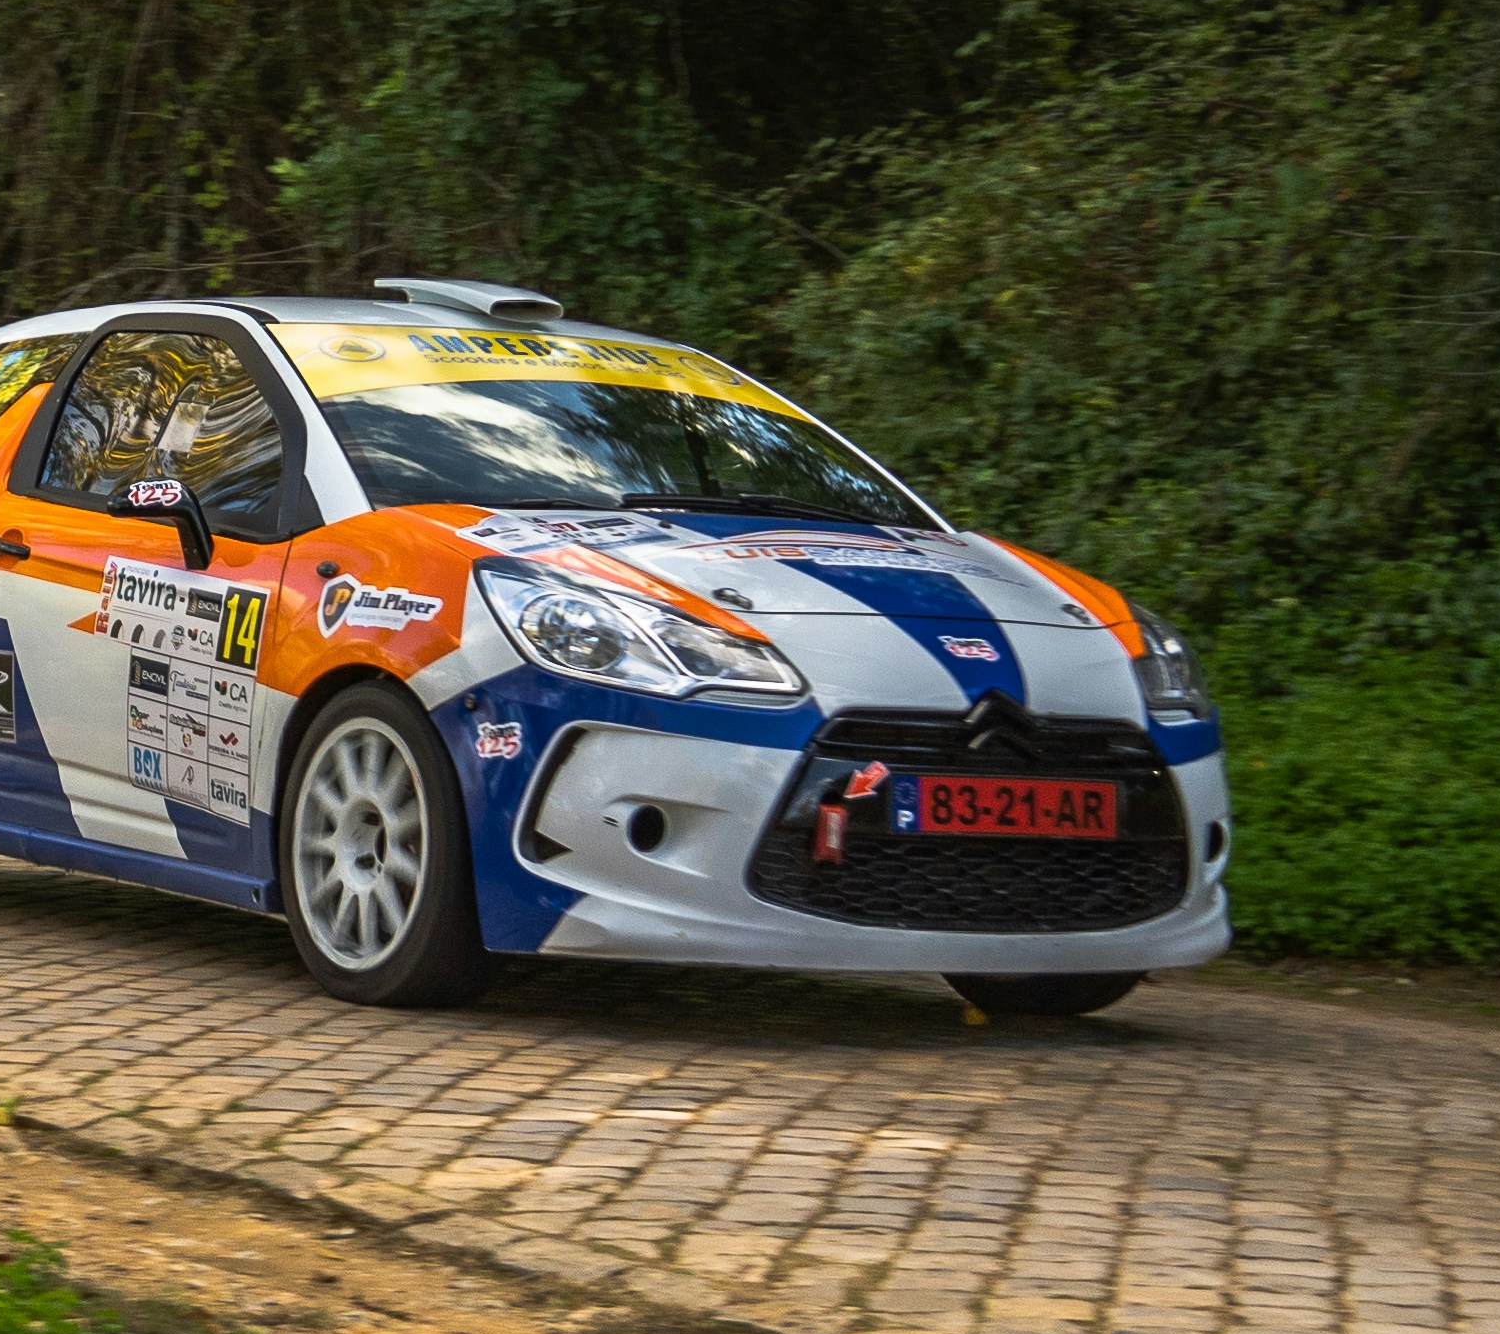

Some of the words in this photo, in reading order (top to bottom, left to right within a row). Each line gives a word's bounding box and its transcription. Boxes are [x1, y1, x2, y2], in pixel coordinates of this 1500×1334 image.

[424, 353, 520, 366] Scooters
[130, 485, 179, 504] 125
[116, 567, 177, 611] tavira
[354, 591, 381, 609] Jim
[381, 593, 436, 616] Player
[199, 630, 214, 648] CA
[222, 593, 261, 665] 14
[229, 682, 248, 703] CA
[478, 737, 519, 756] 125
[210, 778, 248, 810] tavira
[930, 783, 1106, 830] 83-21-AR
[897, 809, 915, 828] P
